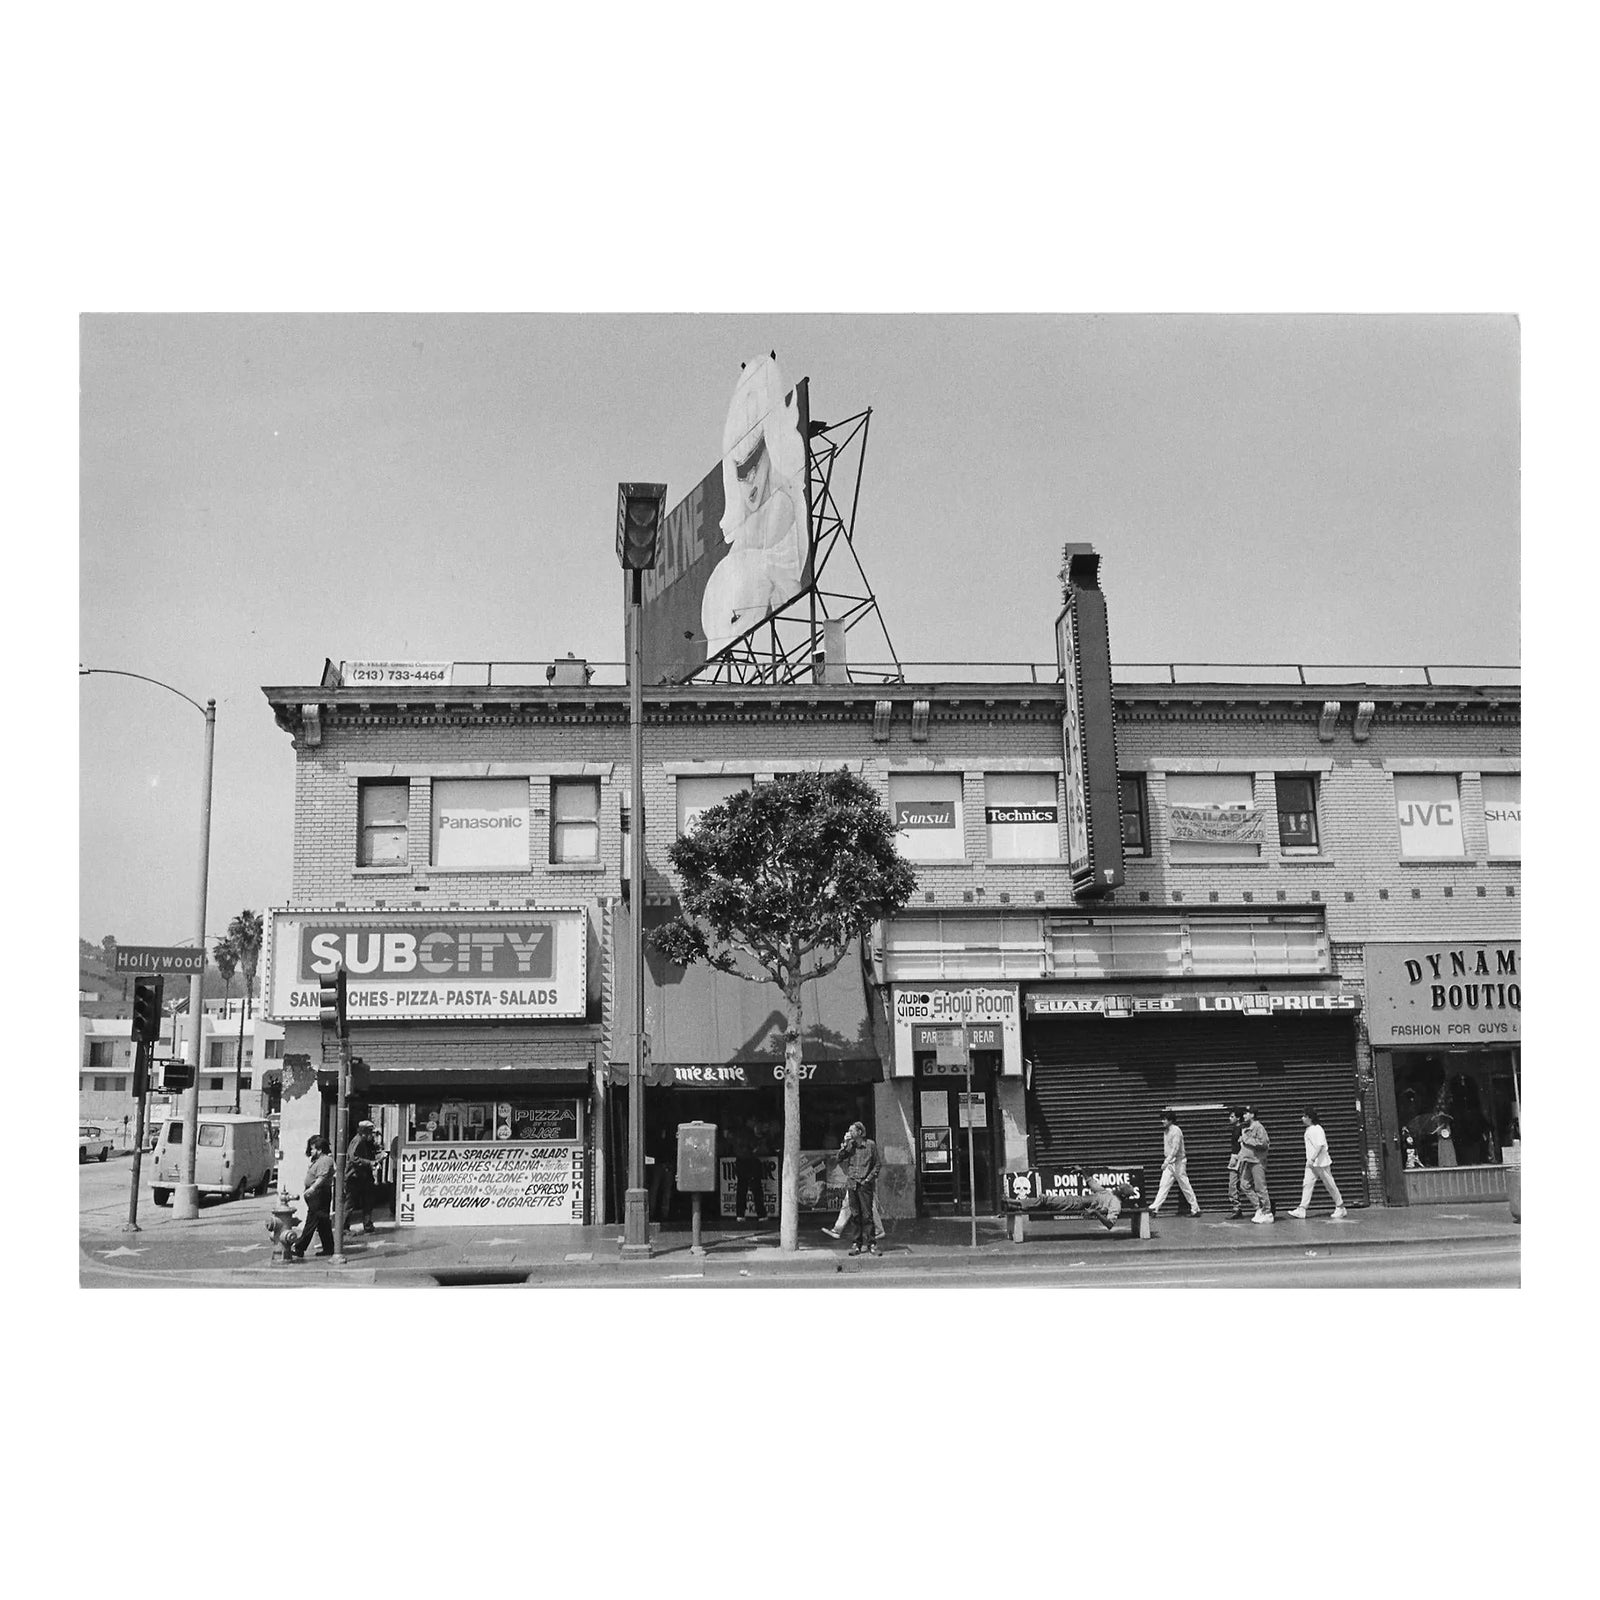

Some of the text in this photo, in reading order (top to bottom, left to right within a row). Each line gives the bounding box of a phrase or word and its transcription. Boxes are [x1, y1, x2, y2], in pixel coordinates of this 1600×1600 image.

[352, 669, 445, 681] (213) 733-4464
[899, 810, 950, 824] Sansui
[987, 809, 1053, 822] Technics
[1400, 804, 1454, 826] JVC
[439, 815, 522, 829] Panasonic
[118, 952, 203, 971] Hollywood
[290, 991, 388, 1008] SANCHES
[897, 994, 930, 1005] AUDIO
[933, 995, 1014, 1013] SHOW ROOM
[1269, 995, 1355, 1009] PRICES
[897, 1006, 929, 1017] VIDEO
[1391, 1025, 1440, 1036] FASHION
[1447, 1024, 1471, 1034] FOR
[1478, 1023, 1508, 1033] GUYS
[973, 1030, 994, 1043] REAR
[773, 1065, 817, 1080] 687
[515, 1109, 576, 1121] PIZZA
[419, 1148, 568, 1160] PIZZA SPAGHETTI SALADS
[420, 1161, 491, 1172] SANDWICHES
[495, 1160, 540, 1172] LASAGNA
[418, 1172, 569, 1184] HAMBURGERS CALZONE YOGURT
[1092, 1173, 1130, 1186] SMOKE
[401, 1154, 416, 1222] MUFFINS
[419, 1185, 439, 1196] ICE
[440, 1185, 478, 1196] CREAM
[525, 1184, 569, 1195] ESPRESSO
[572, 1151, 583, 1219] COOKIES
[423, 1196, 564, 1209] CAPPUCINO CIGARETTES
